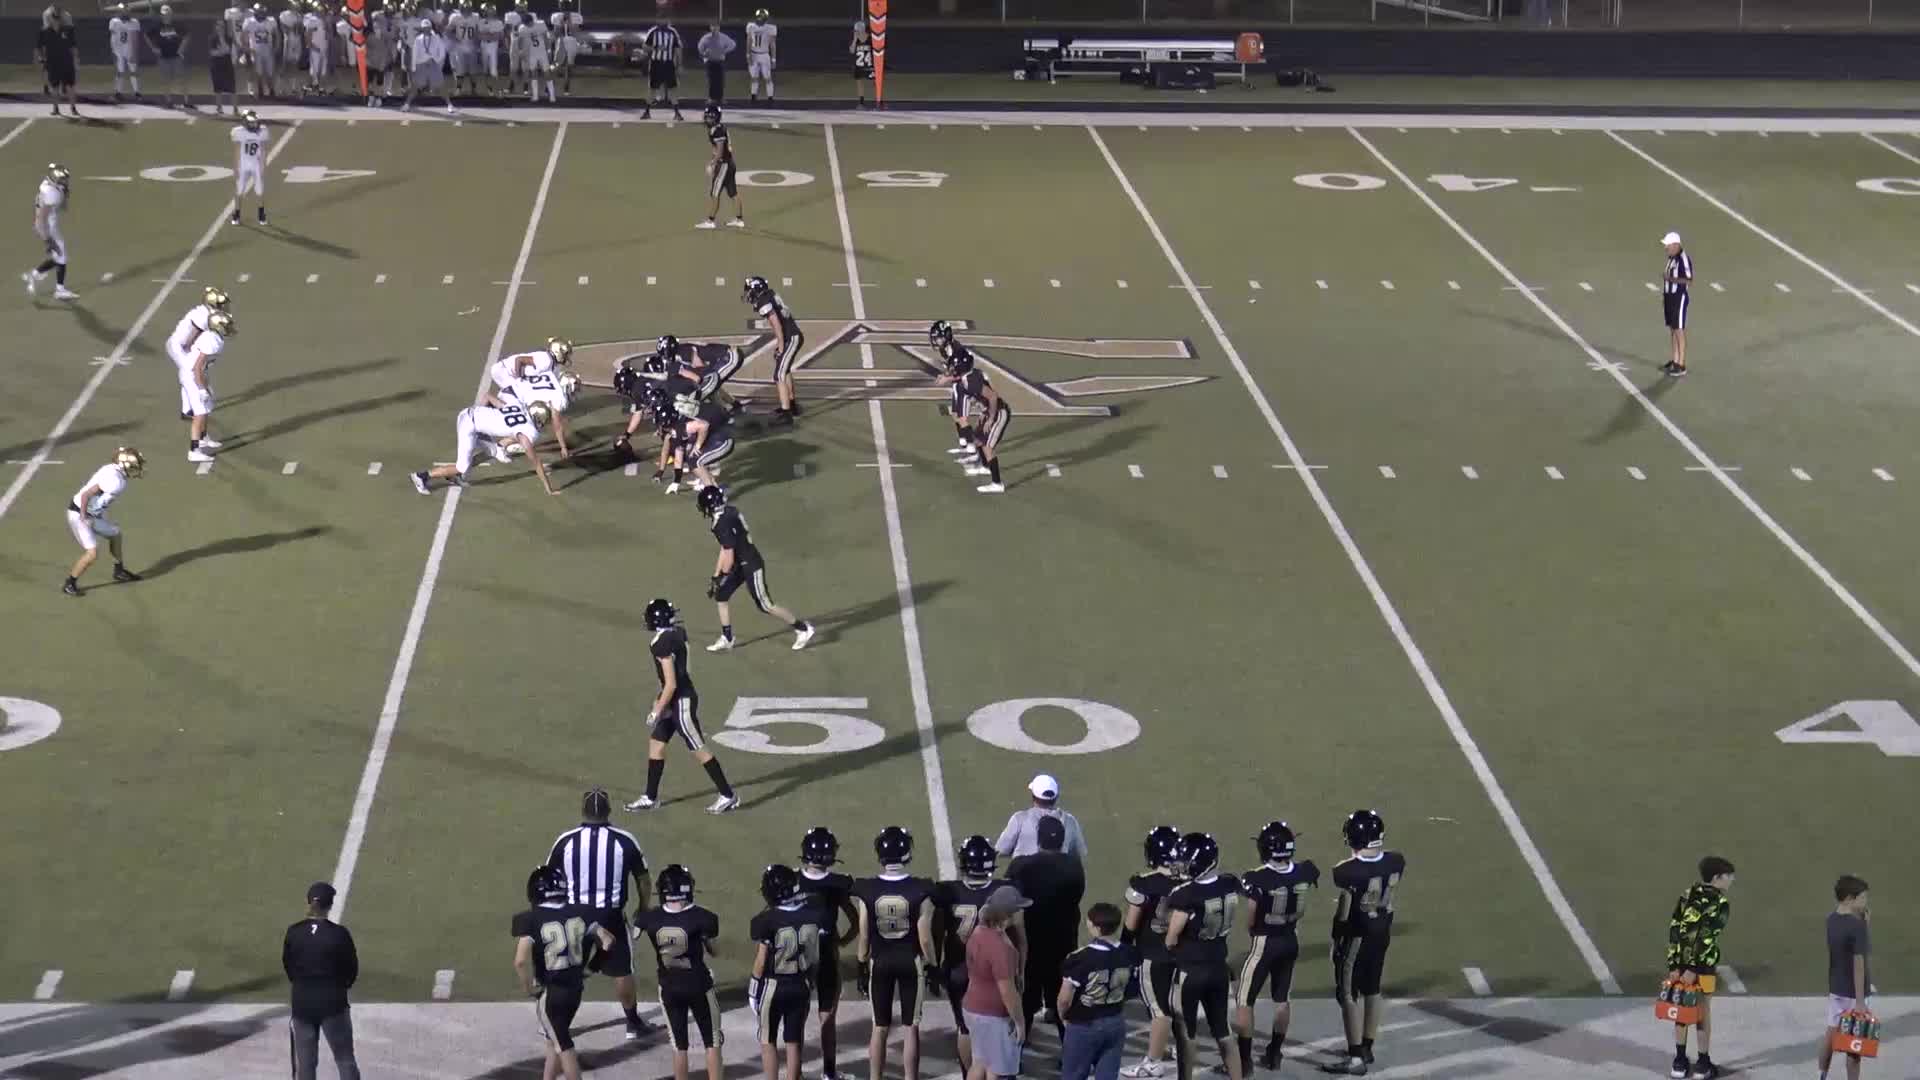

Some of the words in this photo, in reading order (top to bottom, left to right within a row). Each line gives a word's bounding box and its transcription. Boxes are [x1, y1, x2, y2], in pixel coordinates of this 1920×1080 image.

[856, 51, 872, 67] 24
[245, 143, 258, 156] 18
[875, 895, 910, 940] 8
[656, 926, 691, 970] 2
[1667, 1007, 1678, 1019] G
[1850, 1039, 1862, 1052] G
